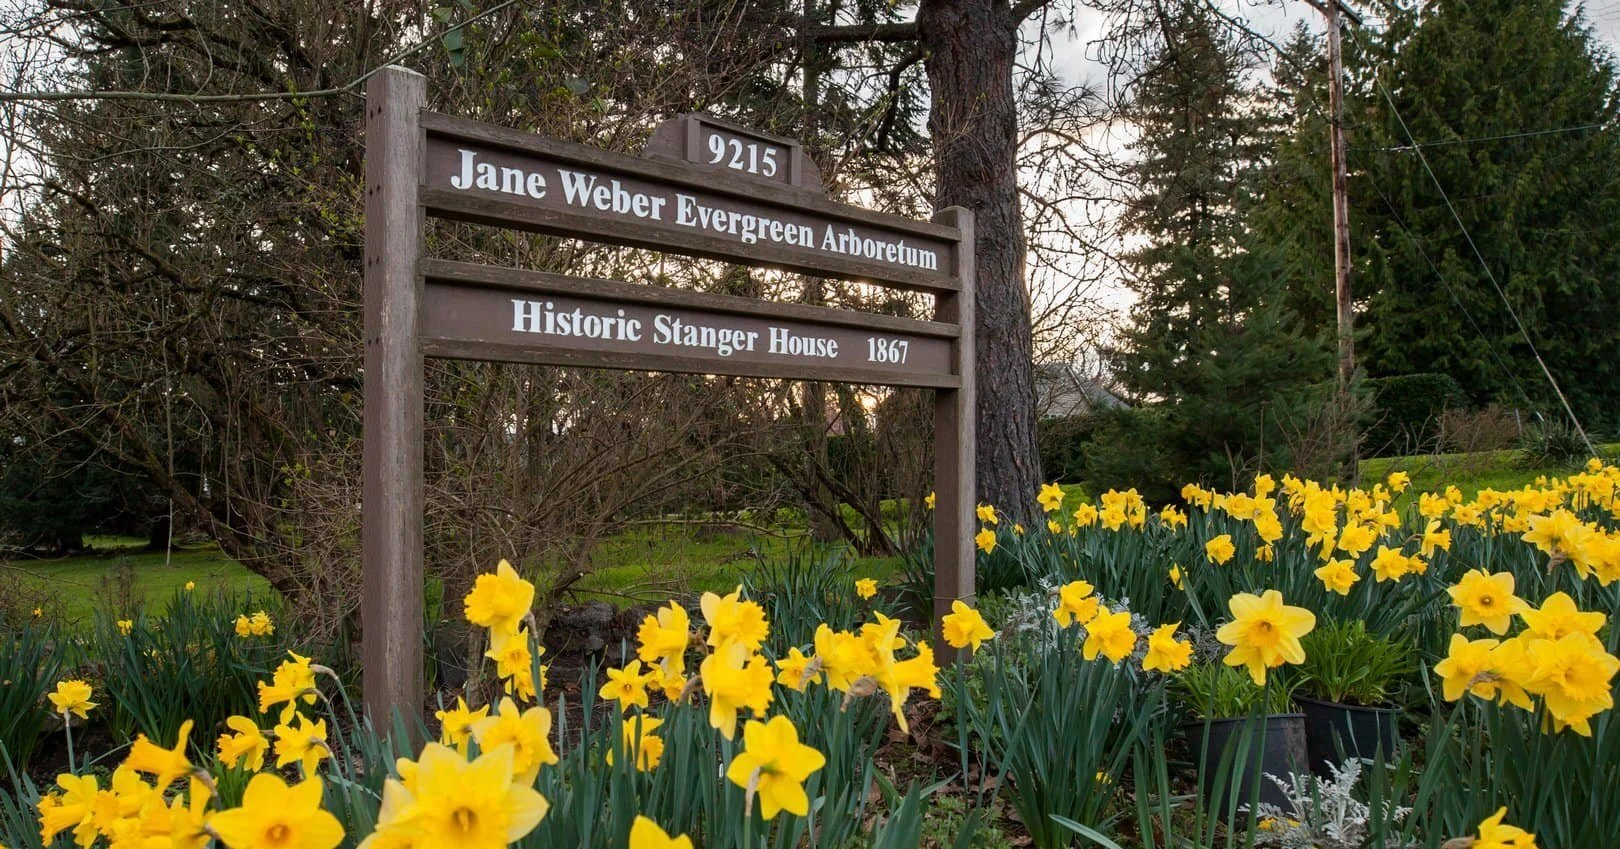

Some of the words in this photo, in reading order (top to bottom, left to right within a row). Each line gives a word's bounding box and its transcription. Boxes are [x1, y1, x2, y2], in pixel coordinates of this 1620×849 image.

[708, 134, 777, 177] 9215
[450, 149, 547, 199] Jane
[557, 169, 666, 221] Weber
[675, 193, 815, 249] Evergreen
[820, 224, 938, 271] Arboretum
[511, 299, 642, 342] Historic
[653, 314, 759, 357] Stanger
[767, 327, 839, 359] House
[866, 337, 909, 365] 1867
